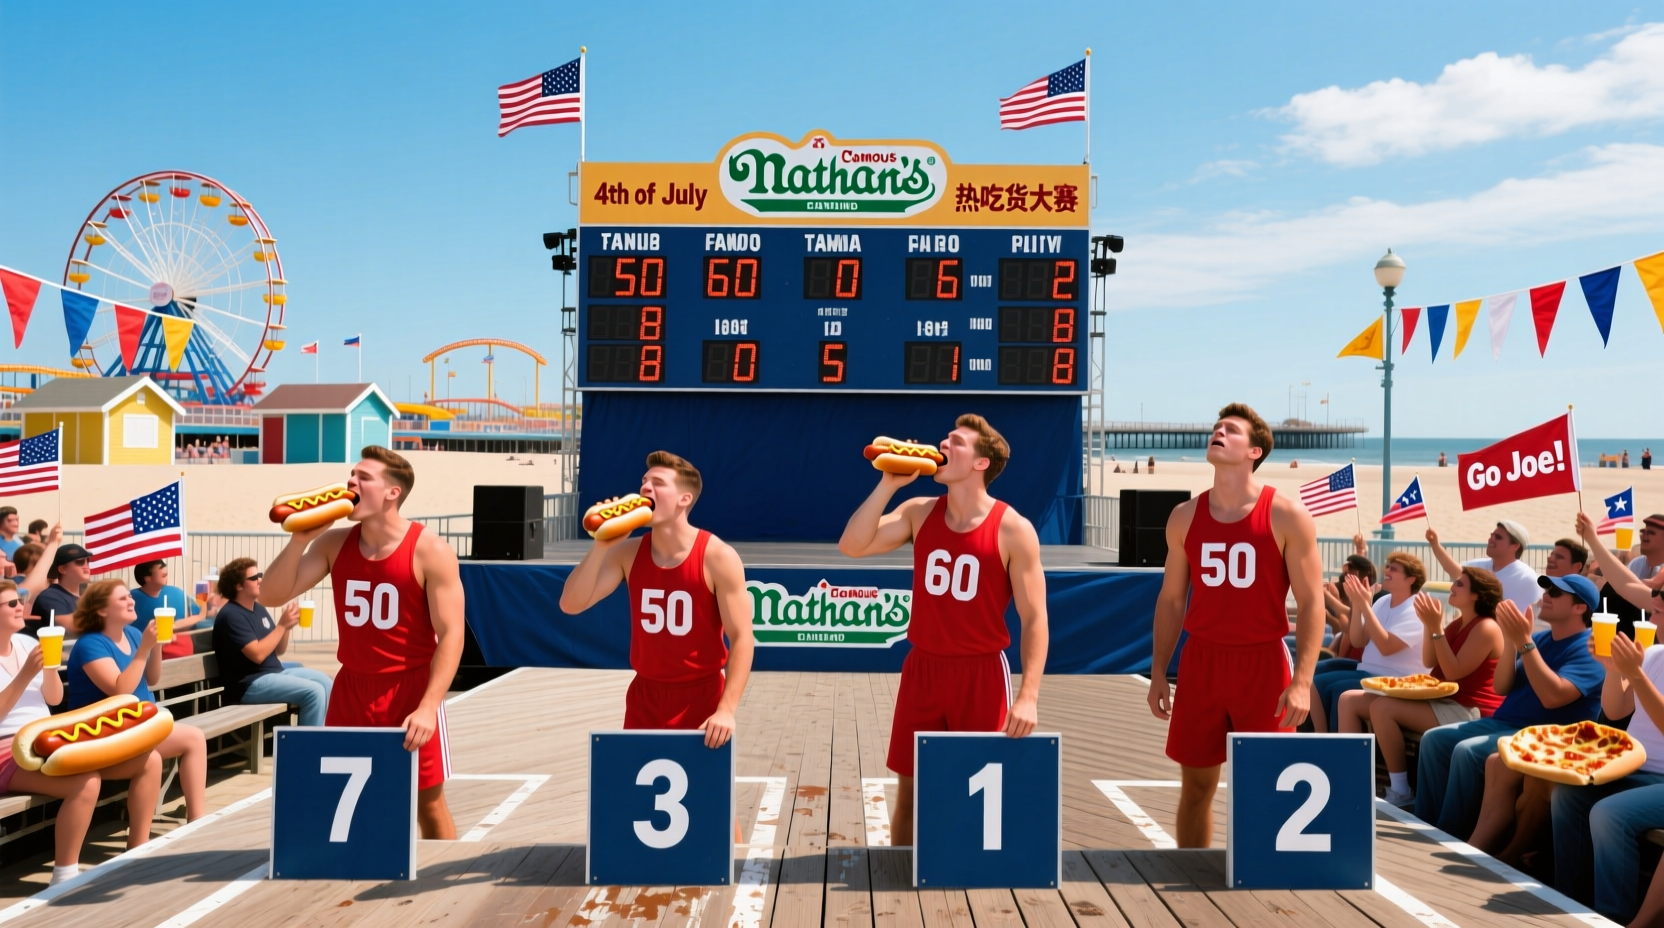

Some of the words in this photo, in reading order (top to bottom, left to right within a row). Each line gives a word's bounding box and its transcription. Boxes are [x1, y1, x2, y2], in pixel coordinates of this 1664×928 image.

[729, 149, 932, 195] Nathan's
[594, 182, 629, 205] 4th
[635, 182, 657, 205] of
[662, 183, 708, 212] July
[955, 182, 1079, 213] 热吃货大赛
[615, 259, 663, 296] 50
[708, 259, 757, 297] 60
[835, 260, 859, 298] 0
[936, 260, 958, 298] 6
[1052, 261, 1075, 299] 2
[639, 307, 661, 341] 8
[1053, 309, 1075, 343] 8
[639, 346, 661, 381] 8
[734, 344, 756, 382] 0
[823, 344, 844, 382] 5
[951, 347, 959, 382] 1
[1052, 349, 1075, 384] 8
[1467, 461, 1501, 491] Go
[1507, 440, 1566, 482] Joe!
[925, 549, 979, 601] 60
[1200, 543, 1255, 589] 50
[345, 580, 398, 630] 50
[641, 589, 692, 635] 50
[747, 586, 910, 628] Nathan's
[321, 757, 373, 843] 7
[633, 759, 689, 849] 3
[968, 763, 1003, 850] 1
[1275, 763, 1331, 851] 2
